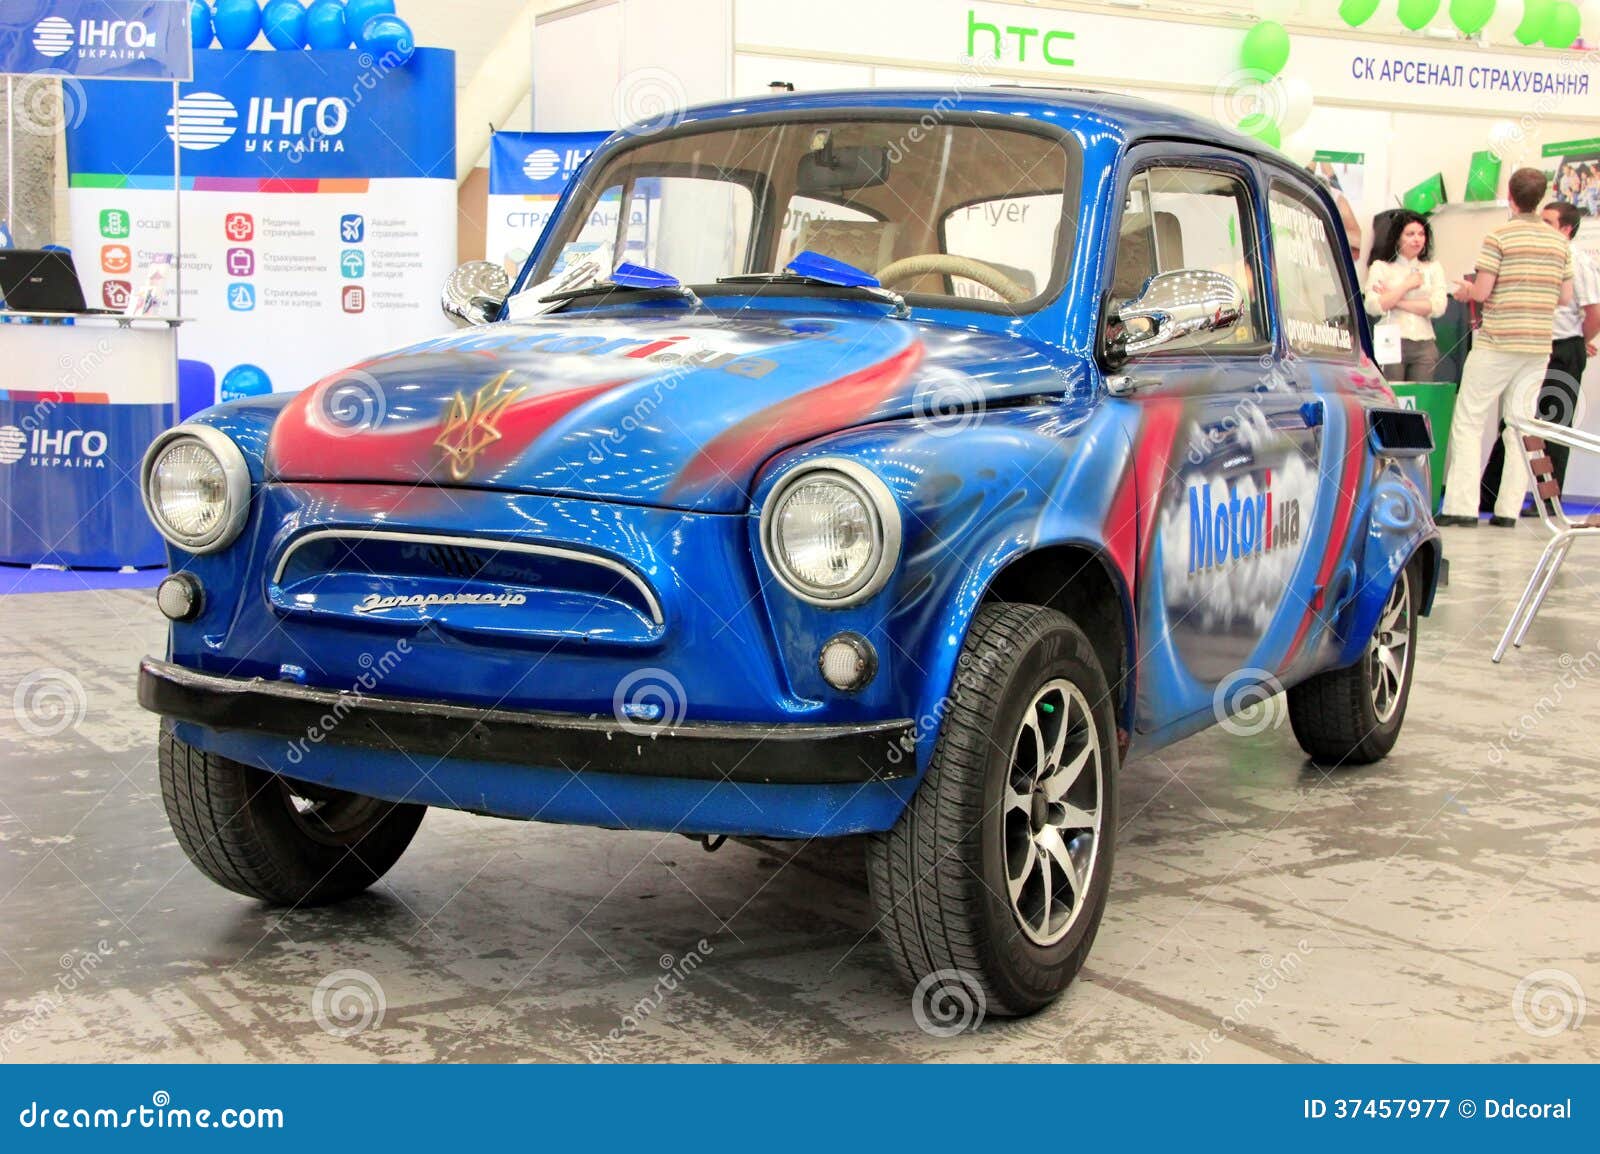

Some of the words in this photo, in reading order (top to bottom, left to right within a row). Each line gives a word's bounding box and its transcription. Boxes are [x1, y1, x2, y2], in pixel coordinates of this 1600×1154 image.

[78, 50, 146, 60] УКРАЇНА
[1352, 56, 1376, 80] СК
[1379, 59, 1464, 87] АРСЕНАЛ
[1468, 67, 1589, 95] СТРАХУВАННЯ
[246, 97, 348, 135] ІНГО
[245, 138, 345, 152] УКРАЇНА
[31, 428, 108, 457] ІНГО
[30, 457, 105, 468] УКРАЇНА
[1188, 467, 1300, 577] Motori.ua
